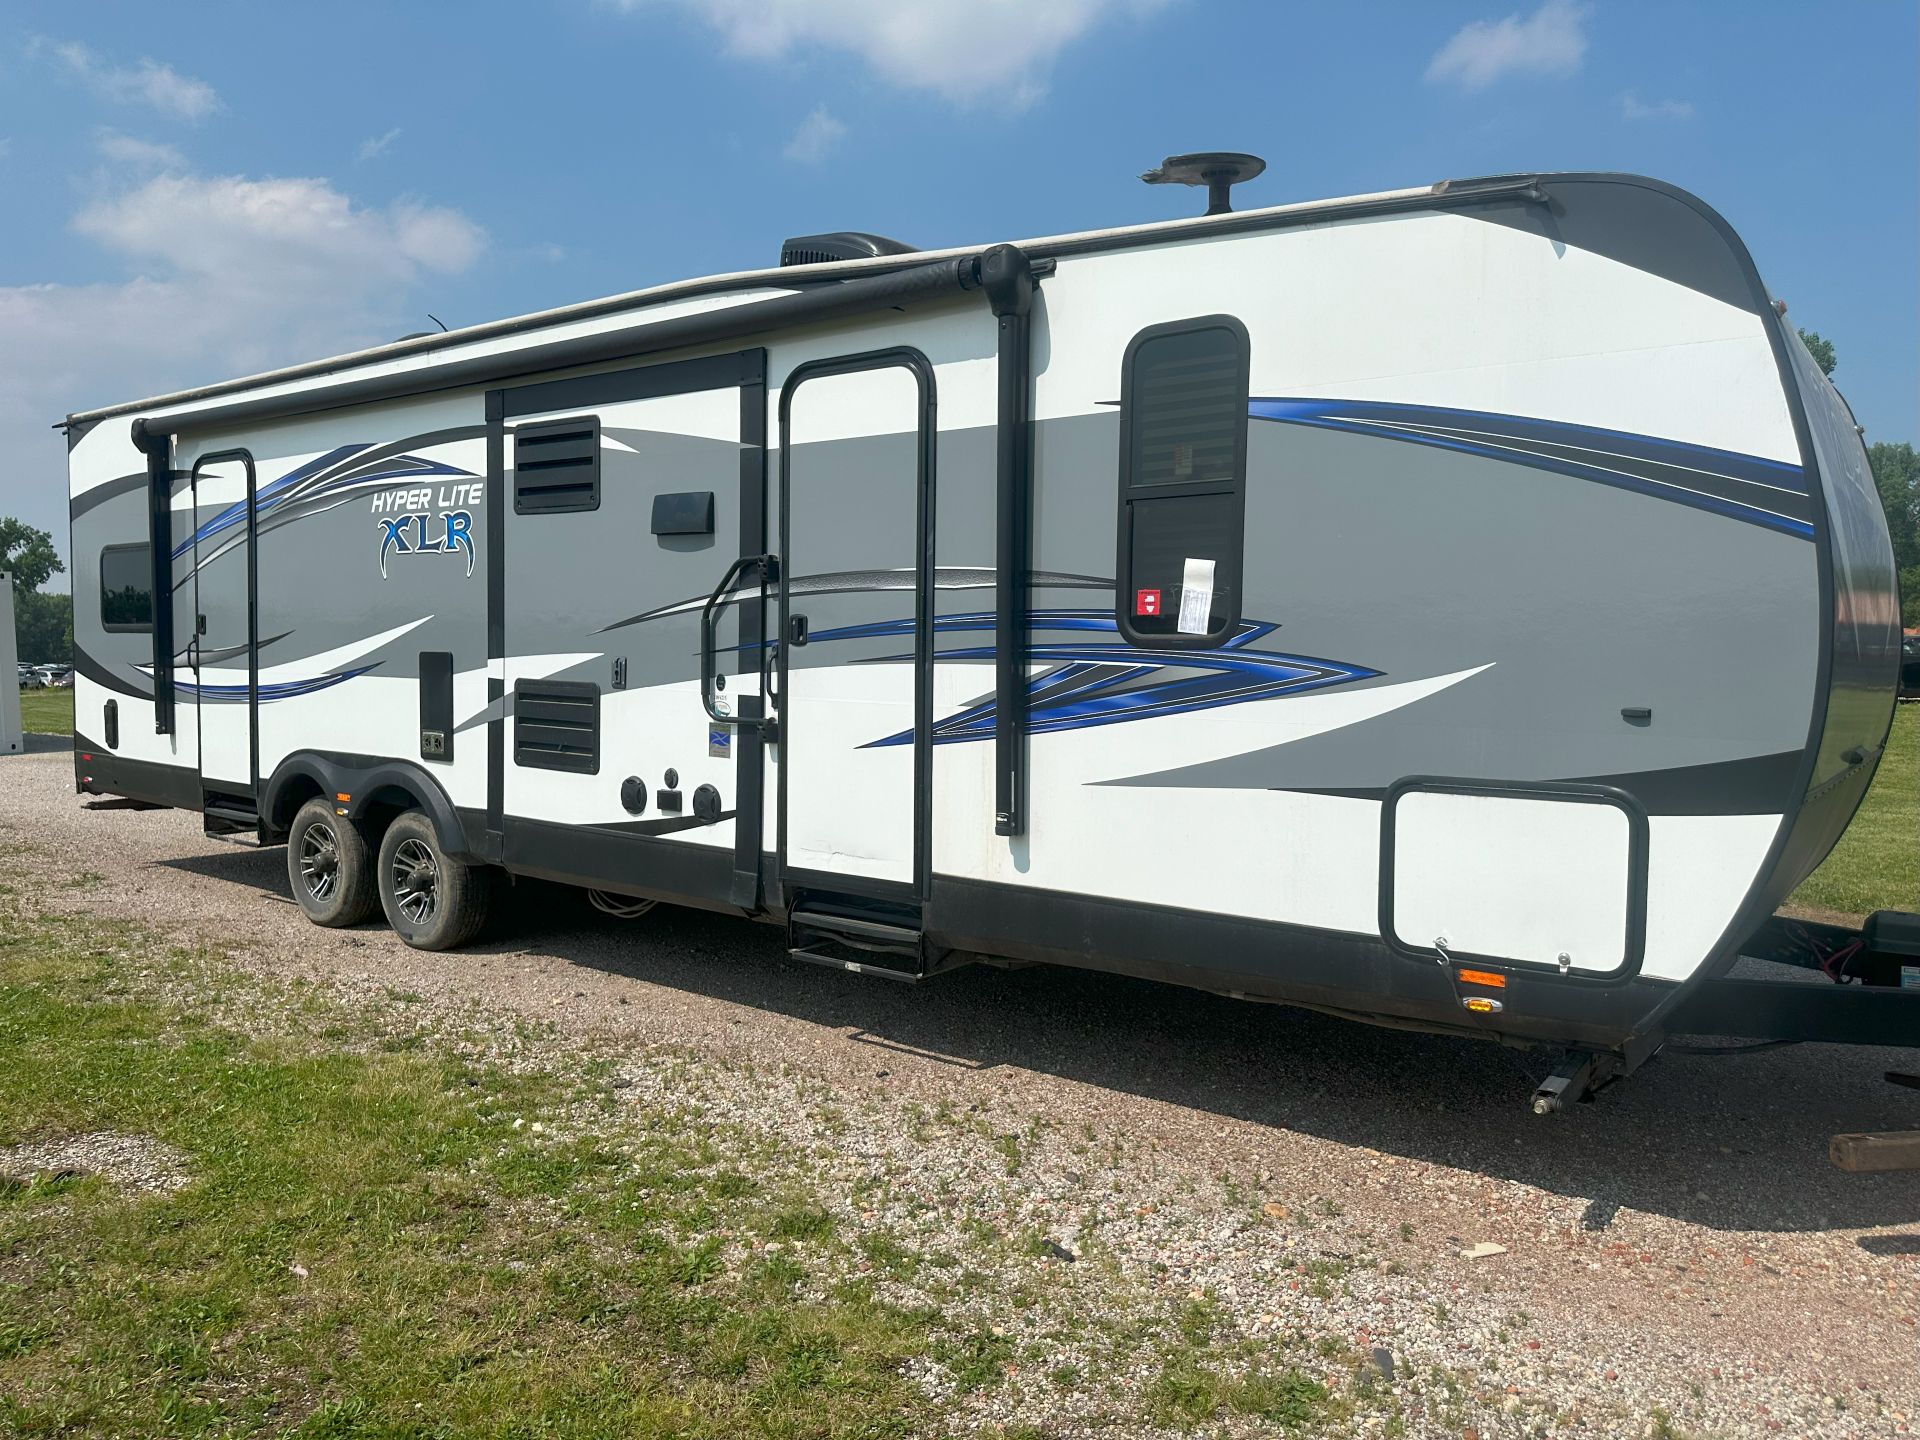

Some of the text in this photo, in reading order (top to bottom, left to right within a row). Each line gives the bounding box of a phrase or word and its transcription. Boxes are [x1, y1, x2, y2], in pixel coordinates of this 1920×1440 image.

[371, 483, 484, 513] HYPER LITE
[377, 509, 476, 580] XLR
